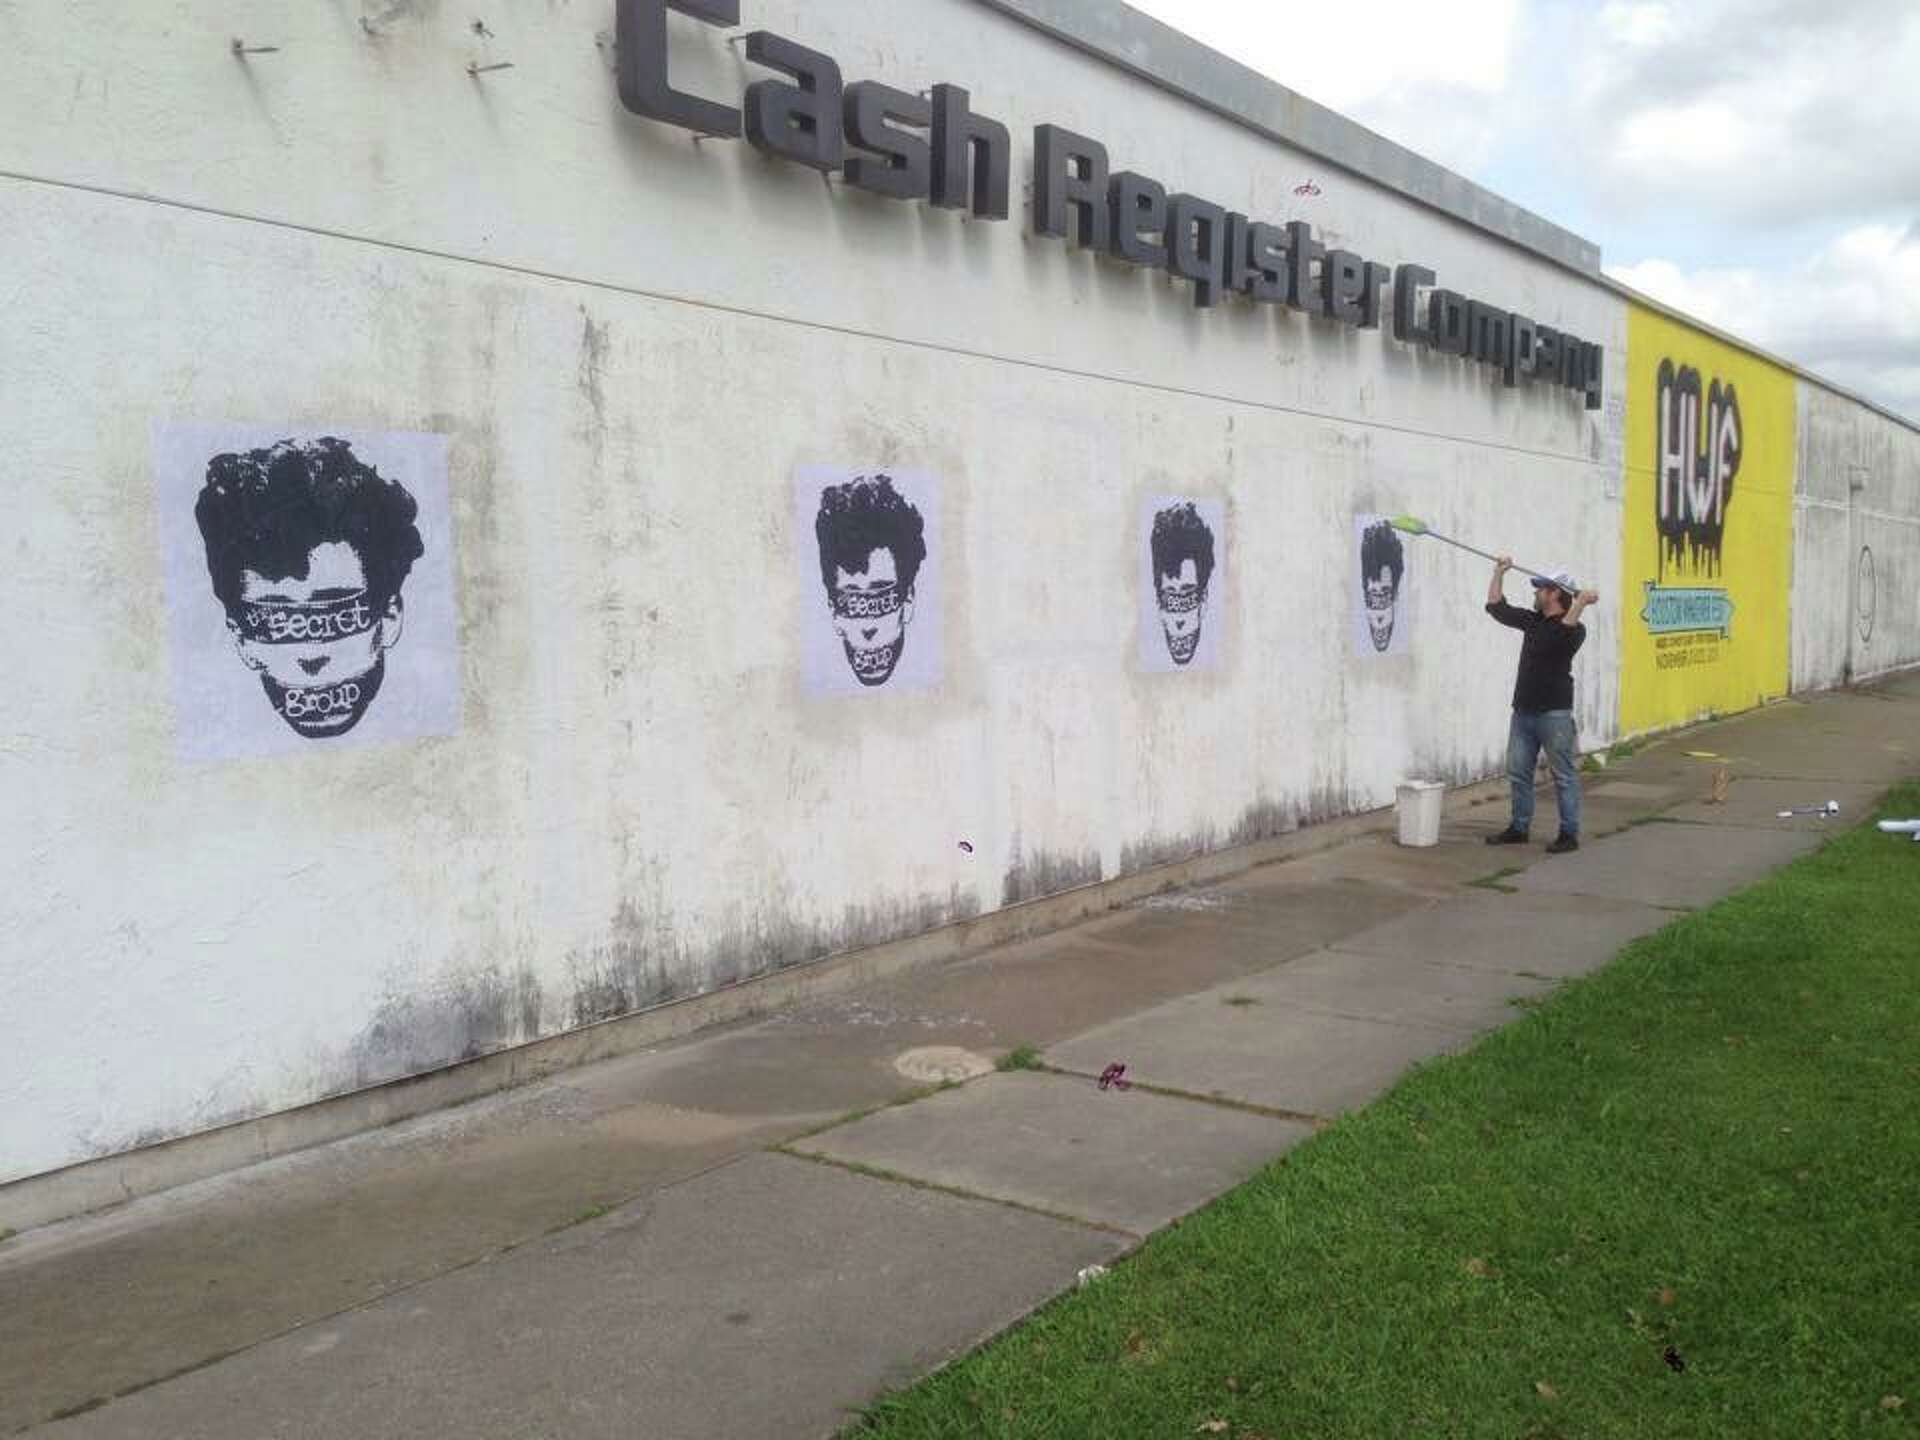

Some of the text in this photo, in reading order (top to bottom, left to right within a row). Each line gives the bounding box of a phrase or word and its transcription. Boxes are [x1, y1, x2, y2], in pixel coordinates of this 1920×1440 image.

[616, 0, 1604, 410] Cash Register Company
[1656, 357, 1743, 545] HWF
[268, 600, 371, 640] secret
[848, 589, 899, 615] secret
[286, 683, 361, 716] group
